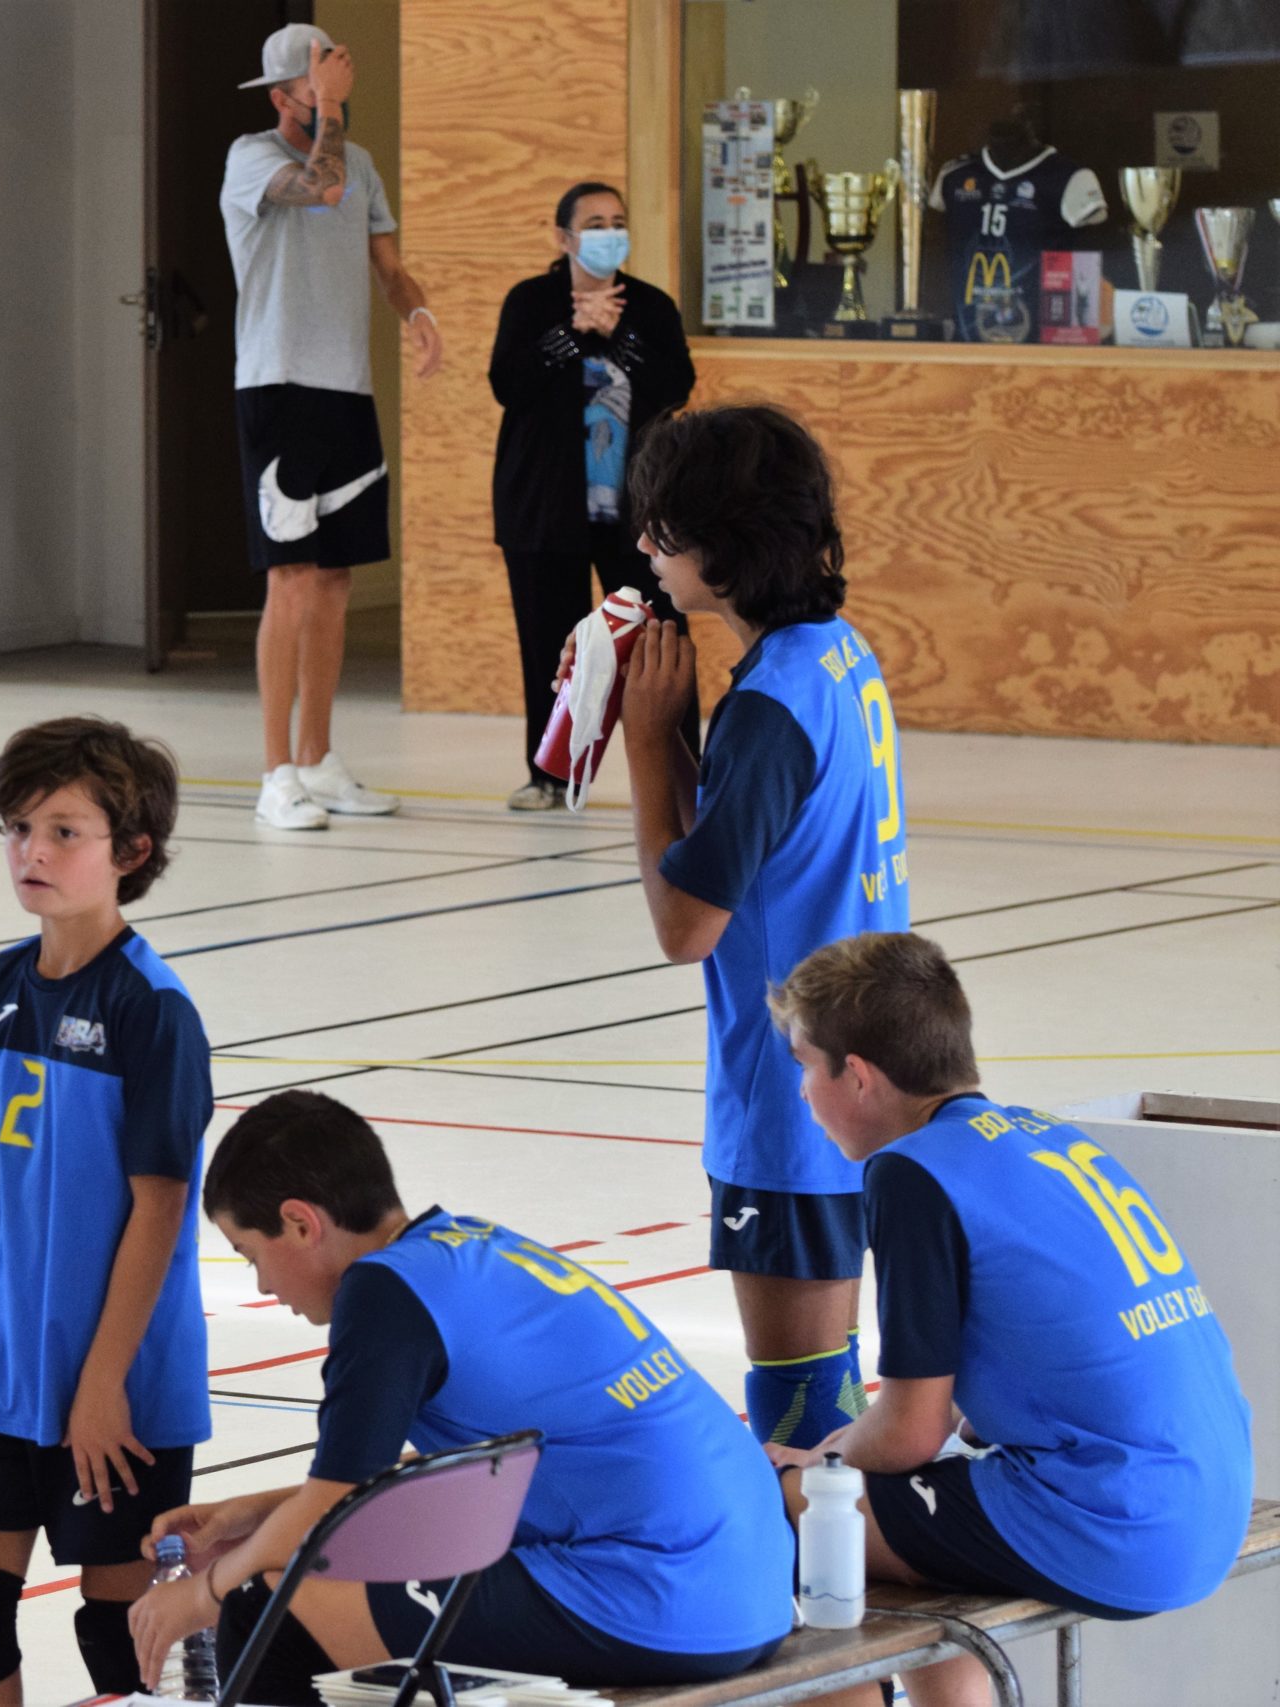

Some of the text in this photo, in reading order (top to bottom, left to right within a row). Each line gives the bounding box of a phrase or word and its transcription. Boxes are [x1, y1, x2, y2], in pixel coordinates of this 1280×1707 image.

[981, 203, 1008, 237] 15
[860, 678, 900, 844] 9
[0, 1059, 46, 1149] 2
[1028, 1141, 1183, 1288] 16
[497, 1241, 650, 1341] 4
[1118, 1289, 1190, 1341] VOLLEY
[605, 1347, 685, 1410] VOLLEY
